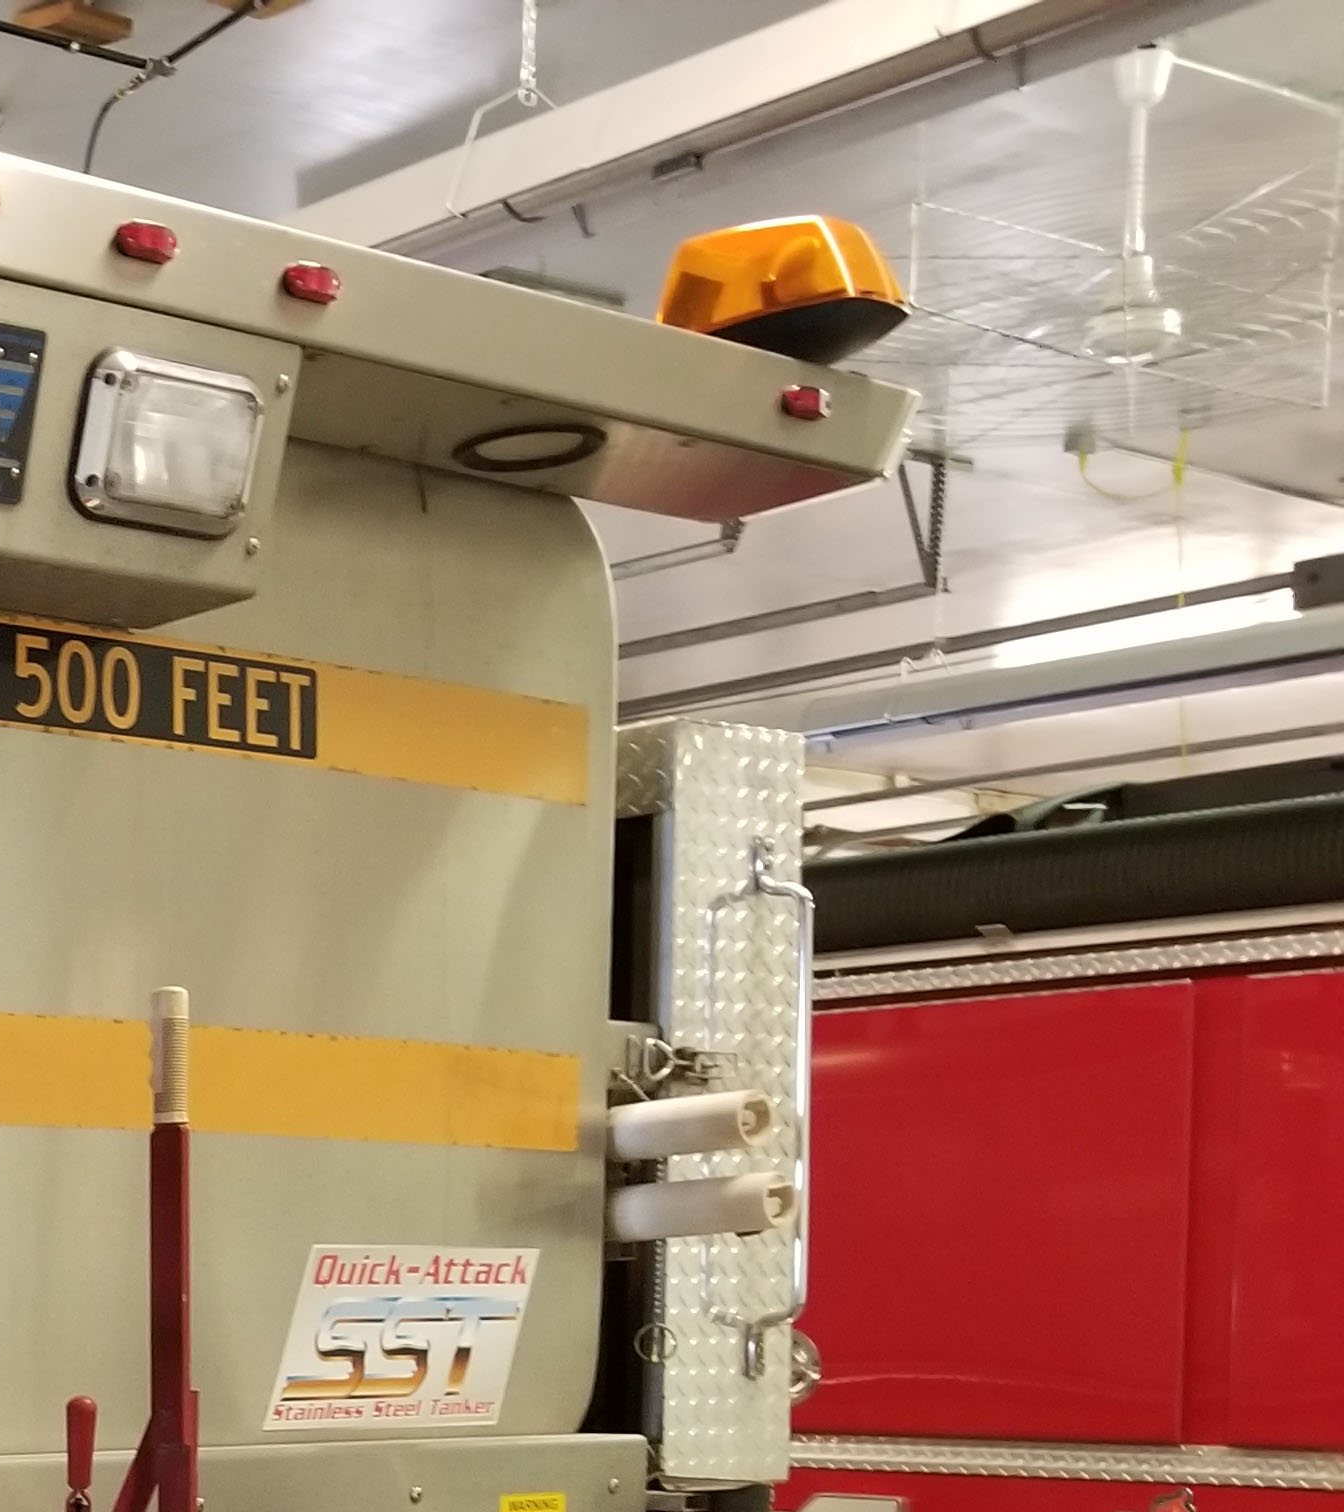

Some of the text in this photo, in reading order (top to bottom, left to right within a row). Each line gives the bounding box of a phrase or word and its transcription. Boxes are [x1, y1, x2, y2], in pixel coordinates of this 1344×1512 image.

[14, 633, 141, 730] 500
[172, 655, 311, 751] FEET
[313, 1254, 528, 1286] Quick-Attack
[279, 1296, 520, 1402] SST
[272, 1398, 497, 1422] Stainless Steel Tanker
